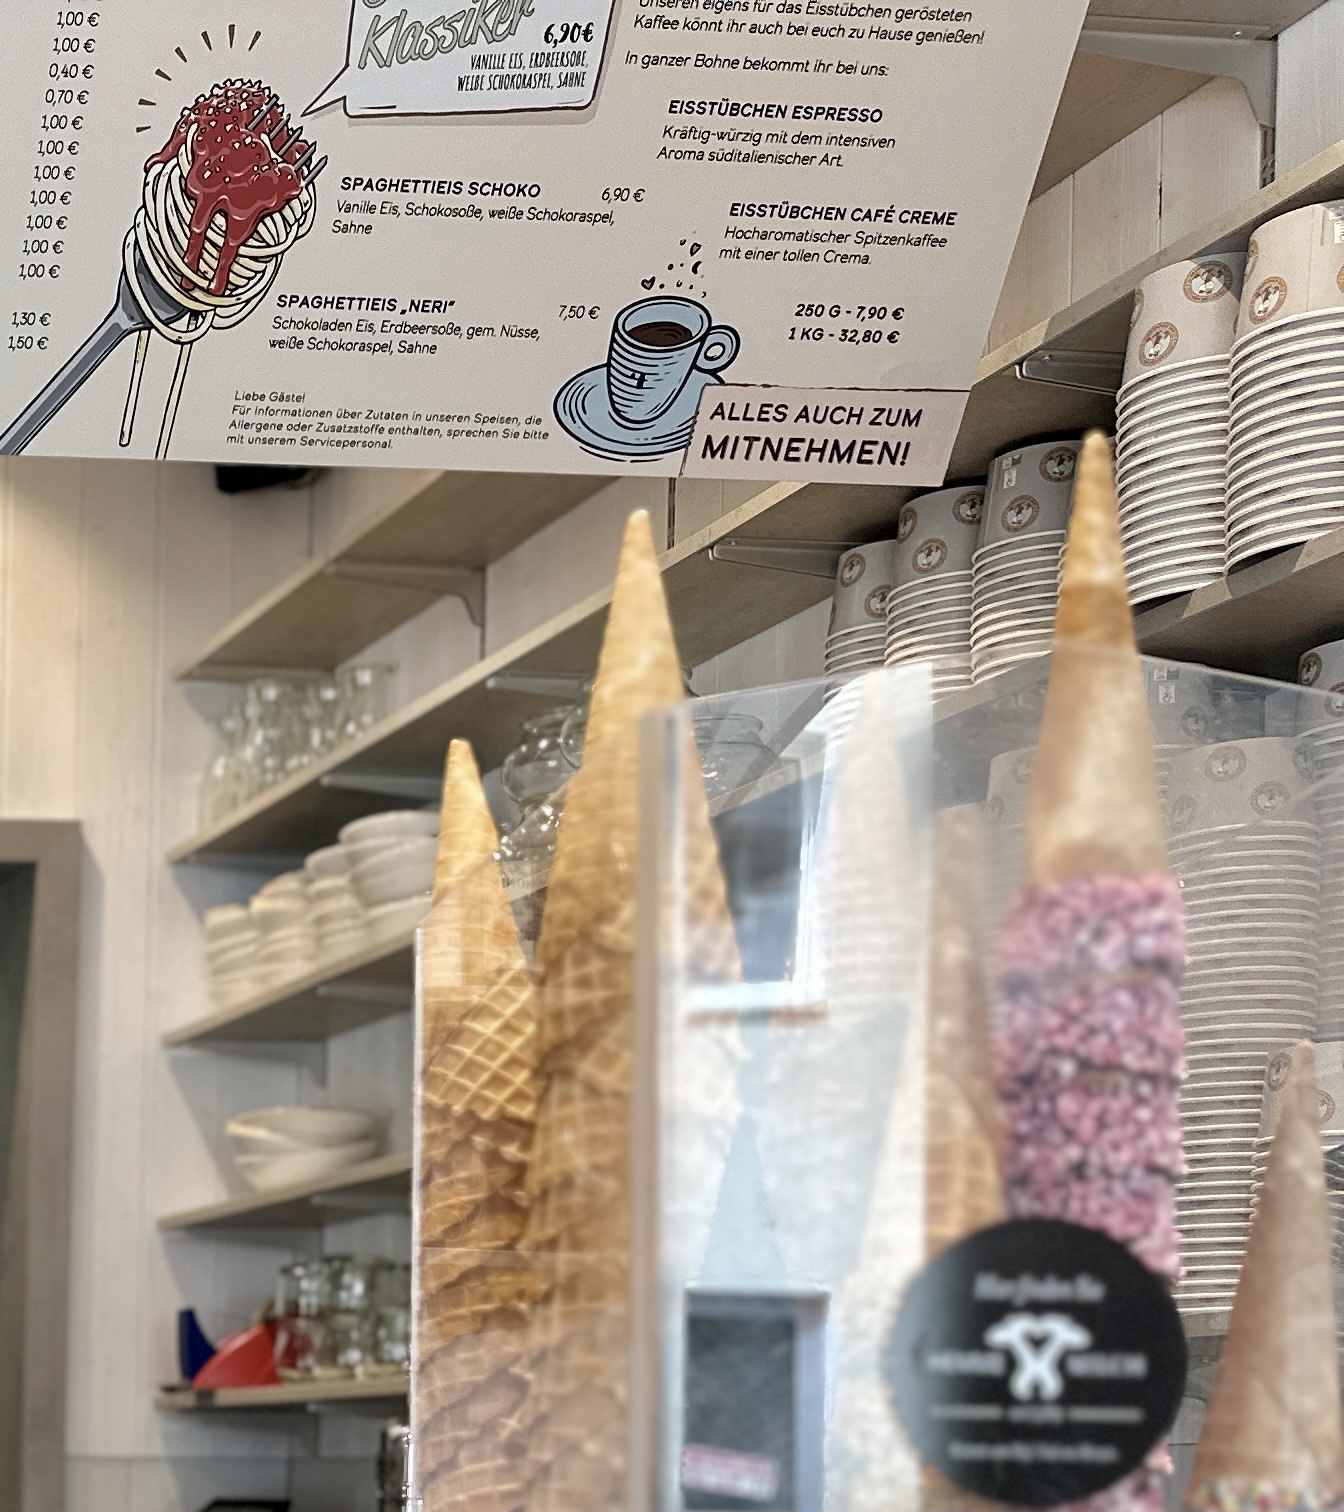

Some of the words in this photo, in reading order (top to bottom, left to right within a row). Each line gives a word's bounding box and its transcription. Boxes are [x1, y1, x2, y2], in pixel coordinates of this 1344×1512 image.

[52, 37, 80, 56] 1,00
[82, 38, 96, 54] €
[543, 22, 595, 48] 6,90€
[48, 62, 79, 81] 0,40
[81, 64, 95, 80] €
[668, 99, 788, 119] EISSTÜBCHEN
[791, 105, 883, 124] ESPRESSO
[656, 145, 705, 161] Aroma
[707, 147, 818, 166] süditalienischer
[817, 152, 844, 168] Art.
[340, 176, 464, 196] SPAGHETTIEIS
[467, 181, 541, 199] SCHOKO
[601, 187, 630, 204] 6,90
[632, 188, 646, 203] €
[729, 200, 848, 221] EISSTÜBCHEN
[850, 204, 896, 224] CAFÉ
[898, 209, 958, 226] CREME
[276, 294, 398, 312] SPAGHETTIEIS
[11, 311, 36, 329] 1,30
[38, 312, 52, 327] €
[234, 390, 266, 402] Liebe
[268, 391, 306, 404] Gäste!
[709, 401, 789, 423] ALLES
[793, 404, 865, 426] AUCH
[868, 407, 923, 428] ZUM
[701, 434, 911, 467] MITNEHMEN!
